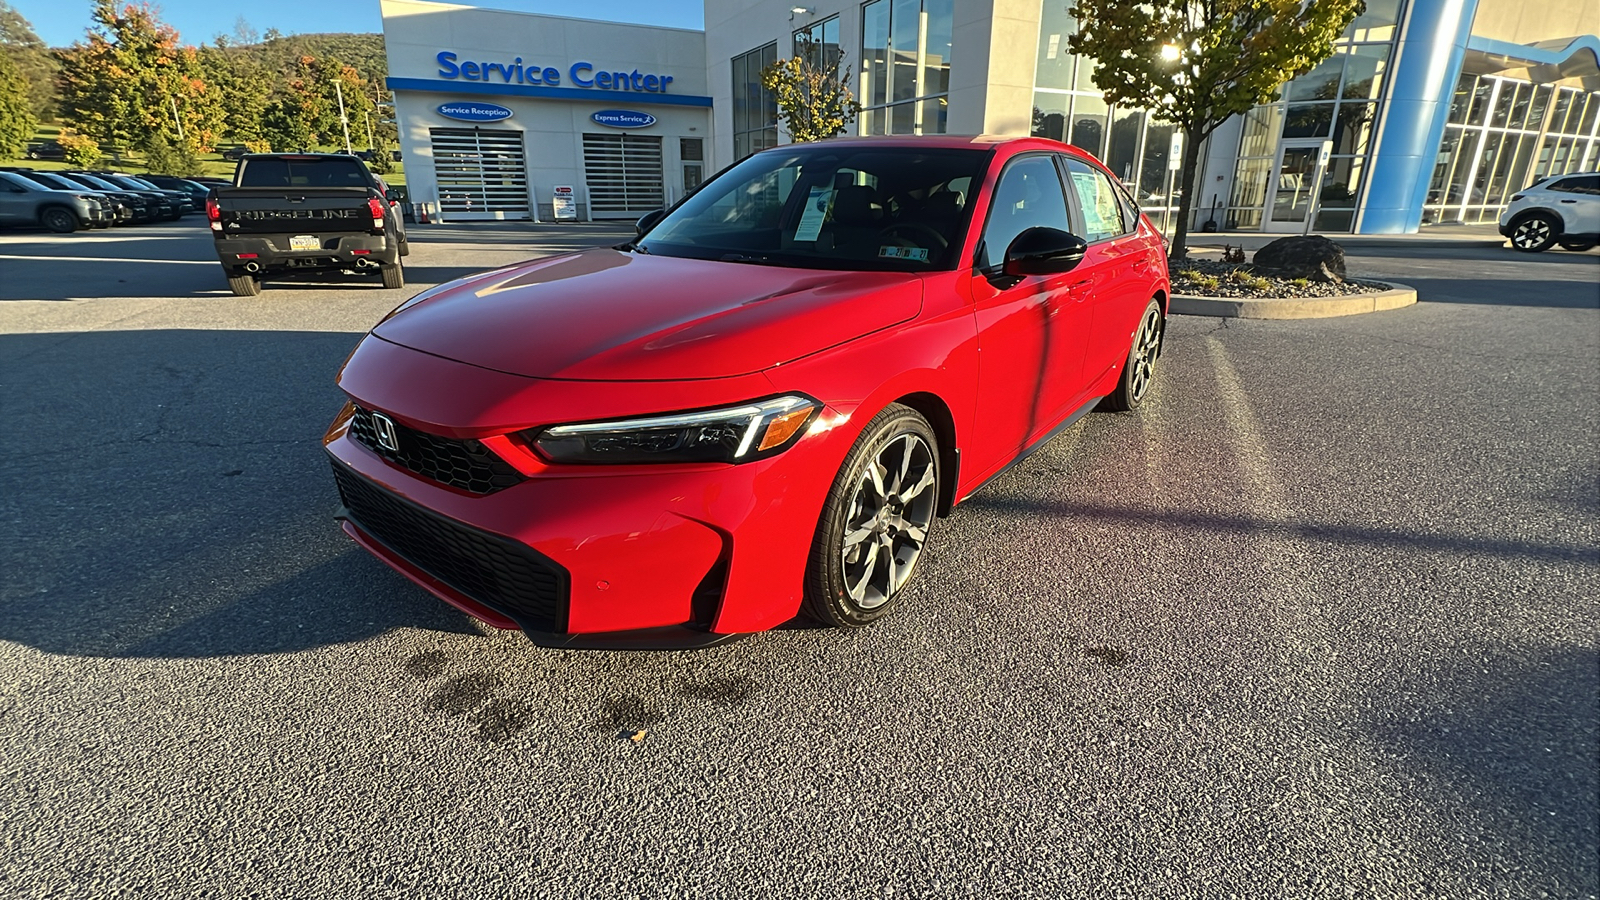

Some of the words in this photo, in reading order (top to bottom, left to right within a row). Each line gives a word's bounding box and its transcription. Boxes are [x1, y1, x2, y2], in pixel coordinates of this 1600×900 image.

[436, 51, 560, 86] Service
[569, 62, 673, 93] Center
[441, 106, 470, 114] Service
[471, 107, 509, 117] Reception
[594, 114, 619, 122] Express
[235, 210, 359, 220] RIDGELINE
